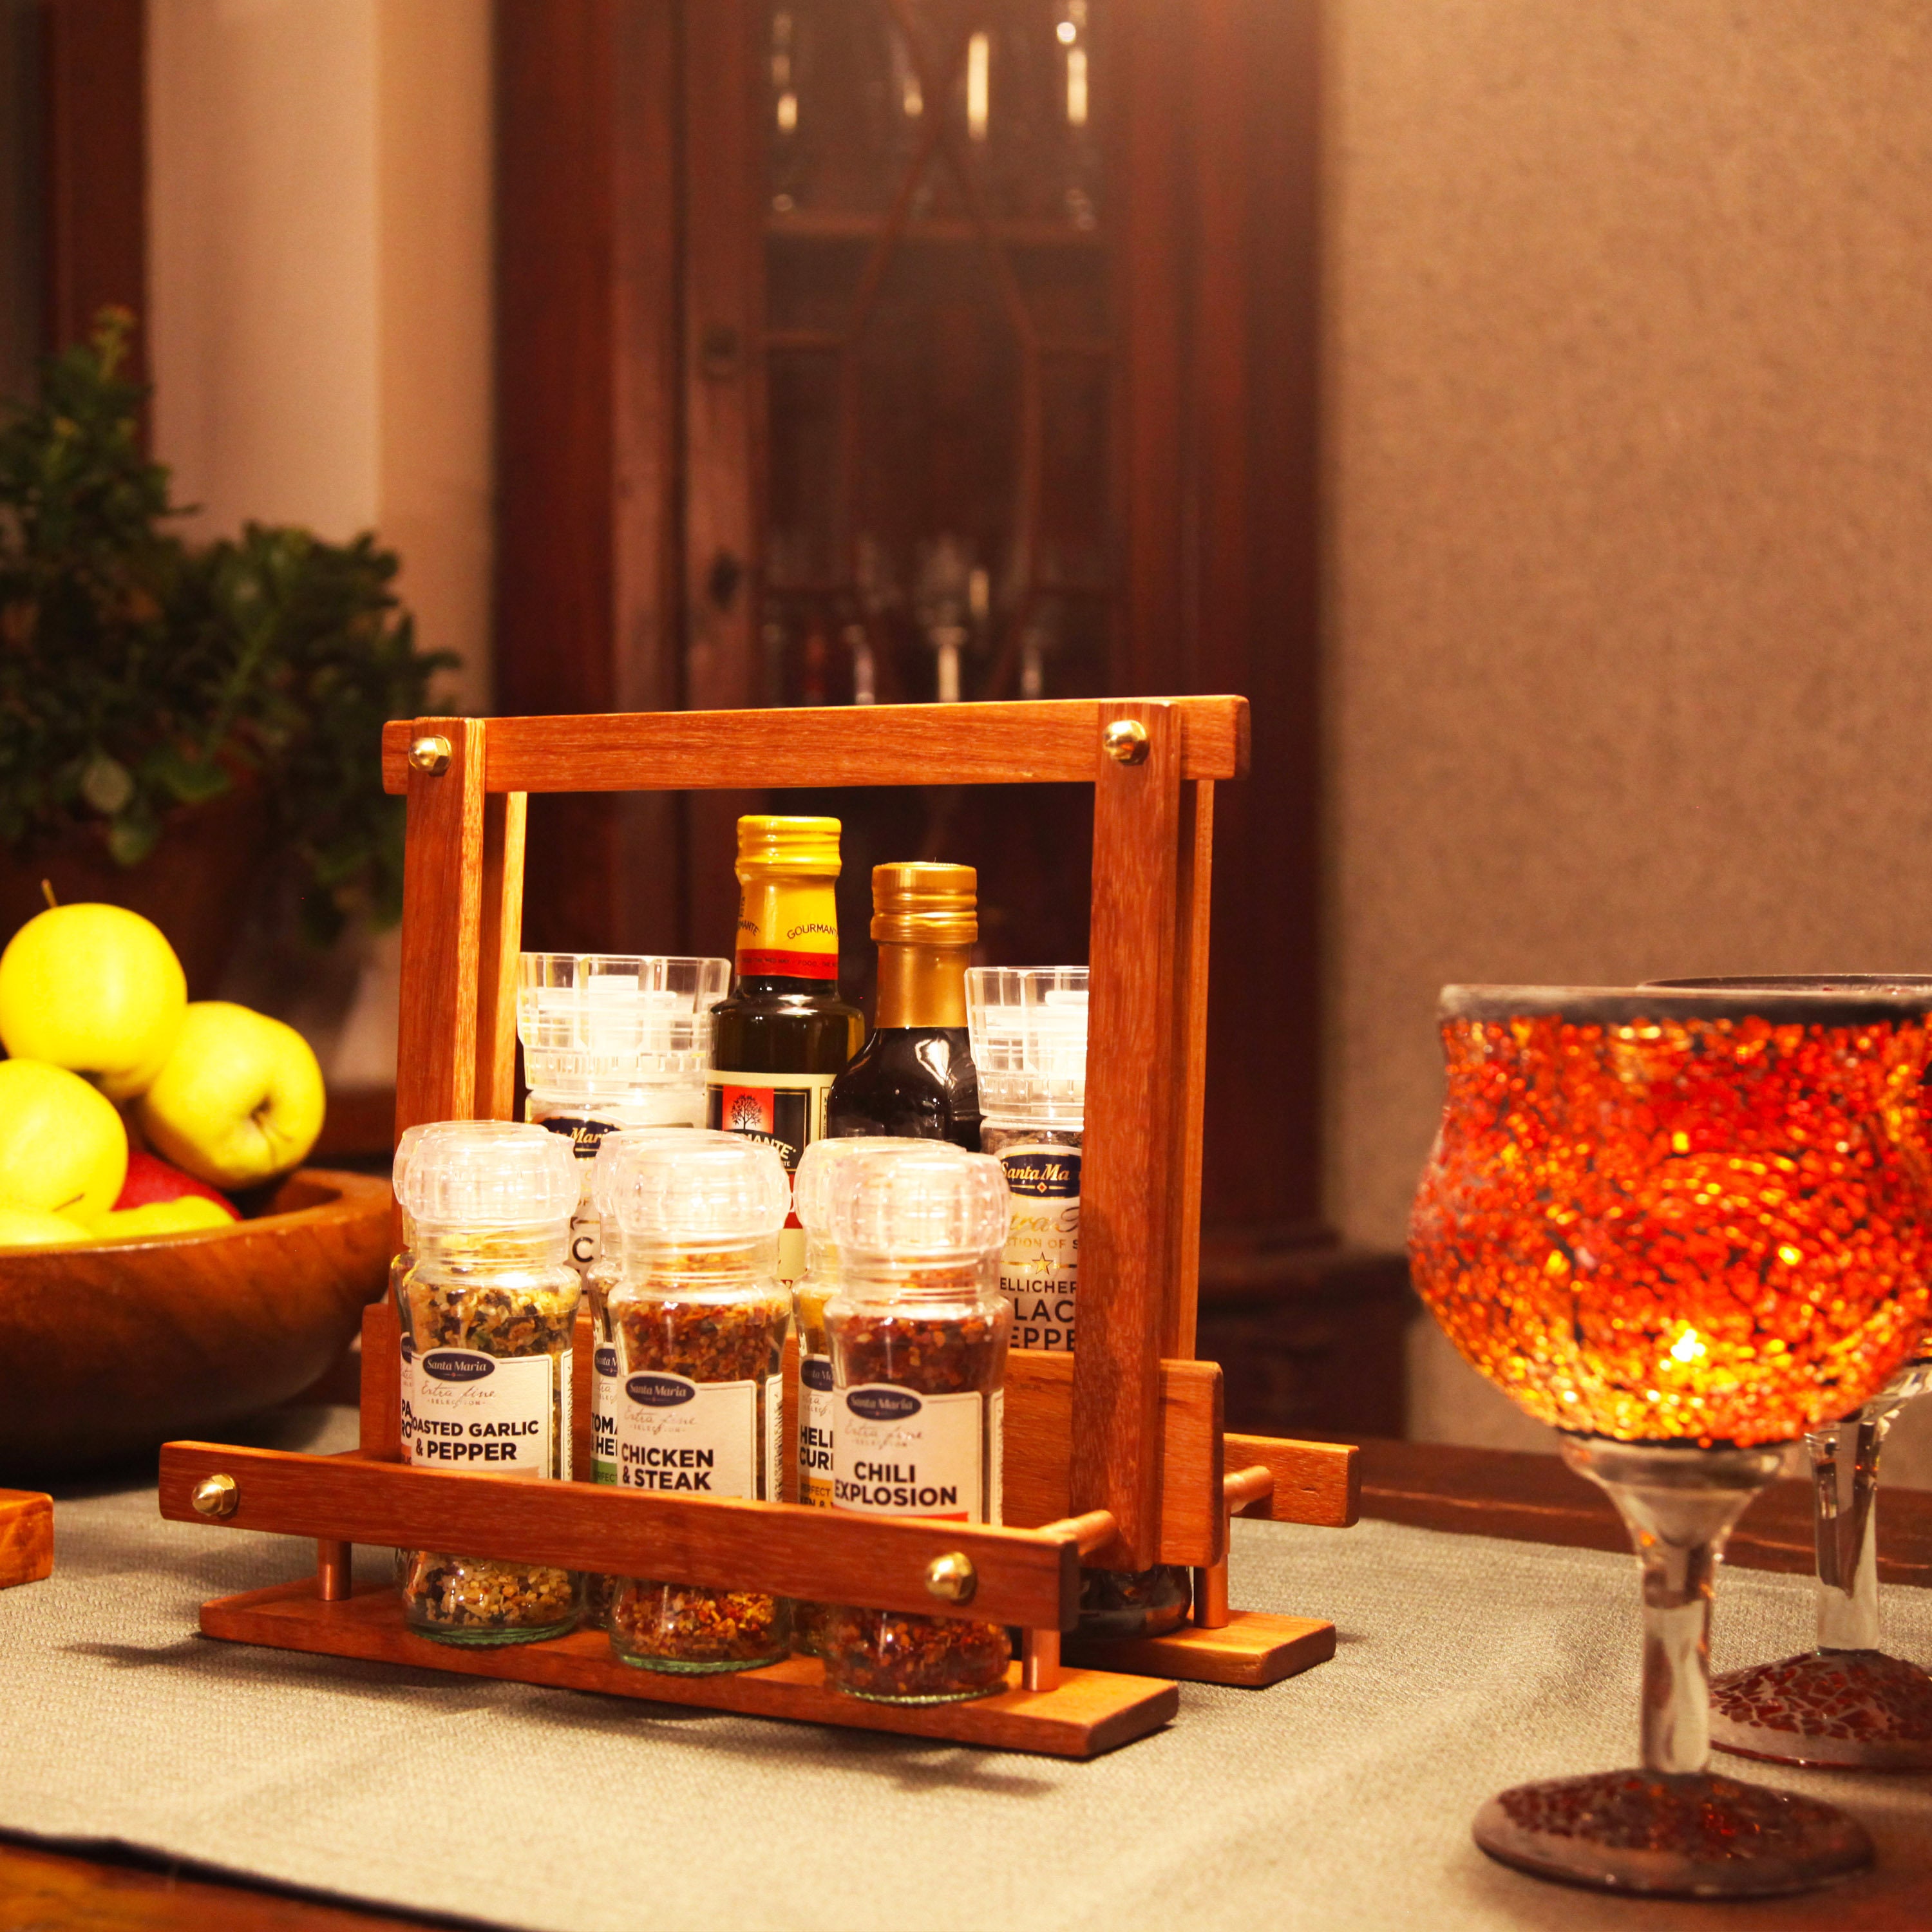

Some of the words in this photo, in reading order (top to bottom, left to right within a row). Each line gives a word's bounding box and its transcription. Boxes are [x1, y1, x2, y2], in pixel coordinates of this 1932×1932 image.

[1001, 1161, 1041, 1180] Santa
[1014, 1298, 1074, 1323] LAC
[1010, 1327, 1075, 1352] EPPE
[426, 1359, 452, 1371] Santa
[453, 1362, 487, 1372] Maria
[629, 1383, 653, 1396] Santa
[654, 1385, 687, 1397] Maria
[412, 1417, 464, 1436] OASTED
[469, 1420, 539, 1437] GARLIC
[416, 1438, 423, 1456] &
[427, 1440, 517, 1461] PEPPER
[621, 1443, 714, 1468] CHICKEN
[622, 1465, 630, 1484] &
[634, 1470, 712, 1490] STEAK
[855, 1461, 916, 1483] CHILI
[835, 1479, 957, 1506] EXPLOSION
